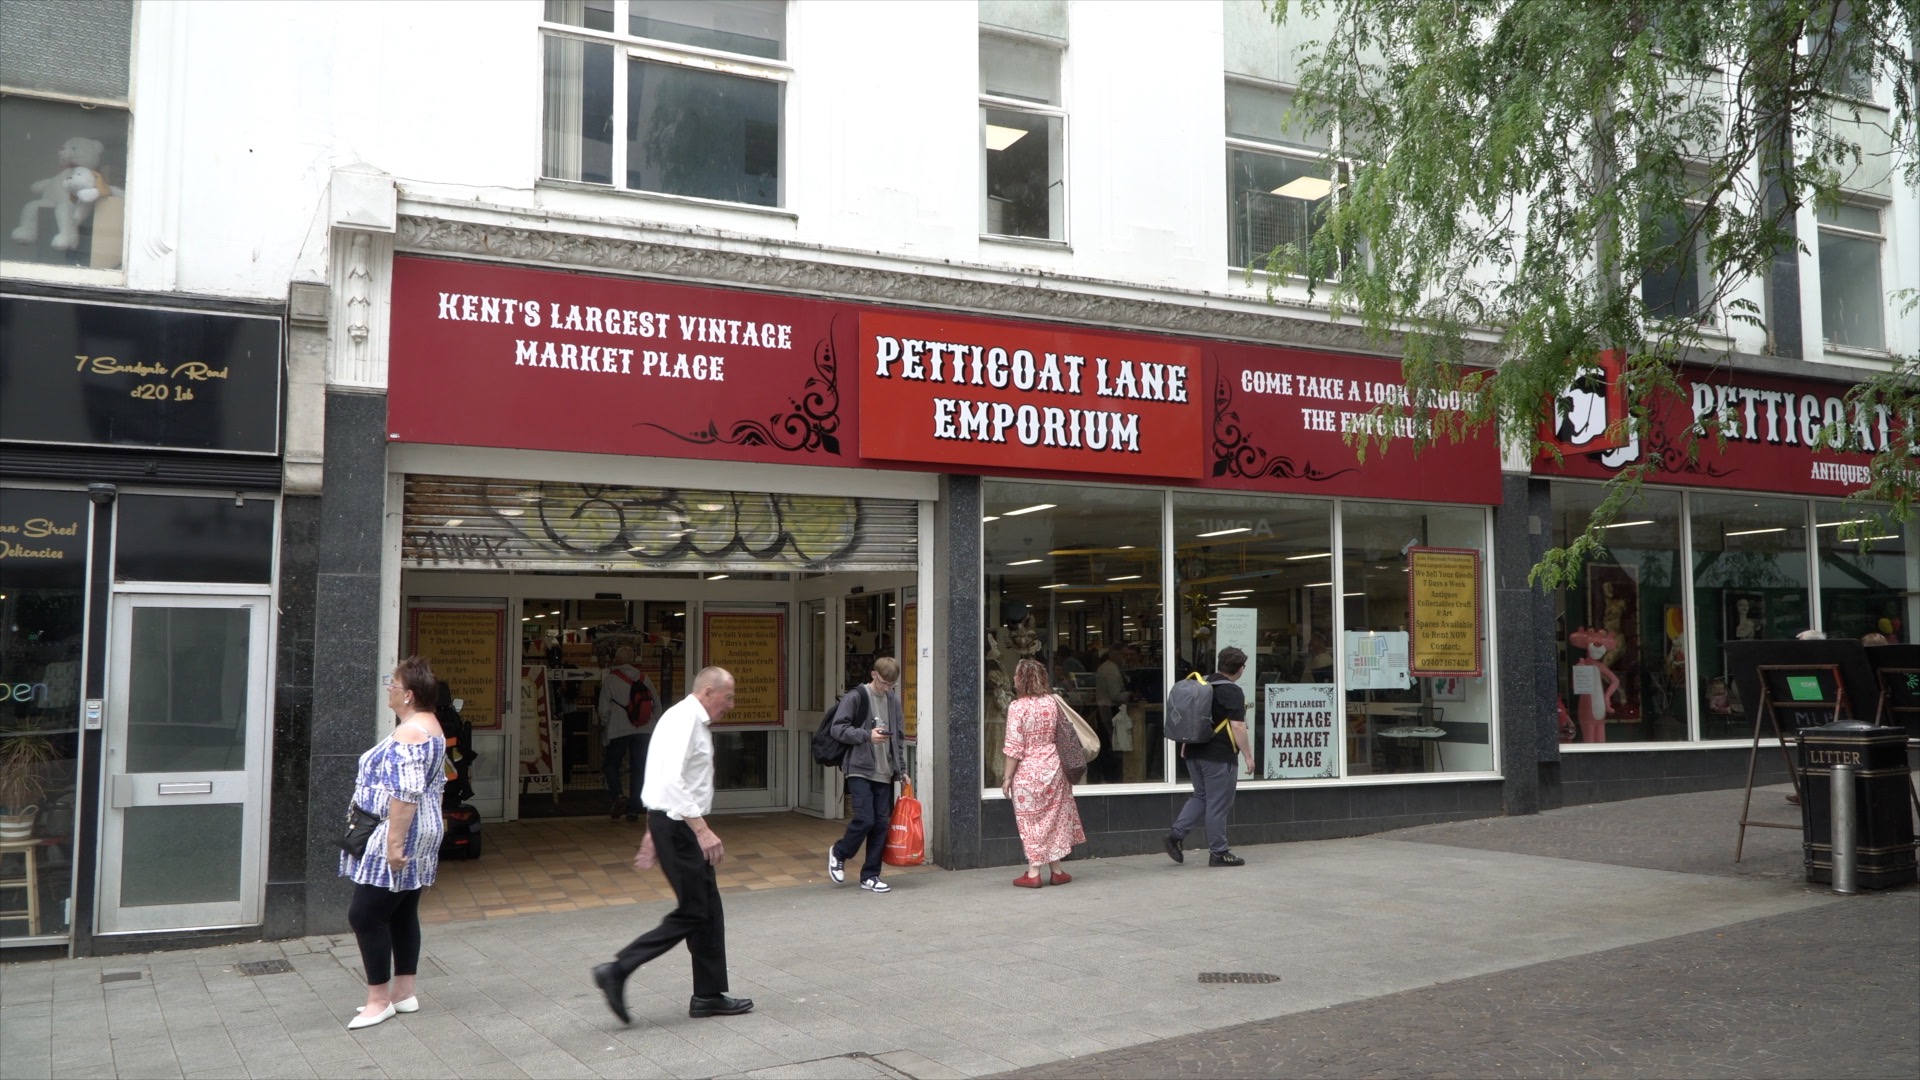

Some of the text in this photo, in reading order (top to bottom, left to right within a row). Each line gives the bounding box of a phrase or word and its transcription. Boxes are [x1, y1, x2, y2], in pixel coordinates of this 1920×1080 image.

[438, 292, 793, 350] KENT'S LARGEST VINTAGE
[75, 356, 228, 380] 7 Sandgate Road
[514, 339, 724, 382] MARKET PLACE
[876, 335, 1188, 403] PETTICOAT LANE
[130, 384, 169, 400] ct20
[1241, 370, 1293, 396] COME
[1296, 375, 1344, 400] TAKE
[1348, 380, 1361, 401] A
[1364, 382, 1410, 406] LOOK
[933, 398, 1140, 452] EMPORIUM
[1302, 408, 1336, 431] THE
[1690, 382, 1892, 452] PETTICOAT
[1811, 461, 1871, 486] ANTIQUES
[23, 518, 78, 538] Street
[1429, 580, 1443, 588] Days
[1431, 591, 1457, 599] Antiques
[1416, 620, 1439, 629] Spaces
[1276, 700, 1326, 708] KENT'S LARGEST
[1271, 712, 1331, 728] VINTAGE
[1272, 732, 1330, 748] MARKET
[1279, 751, 1321, 768] PLACE
[1810, 751, 1861, 764] LITTER
